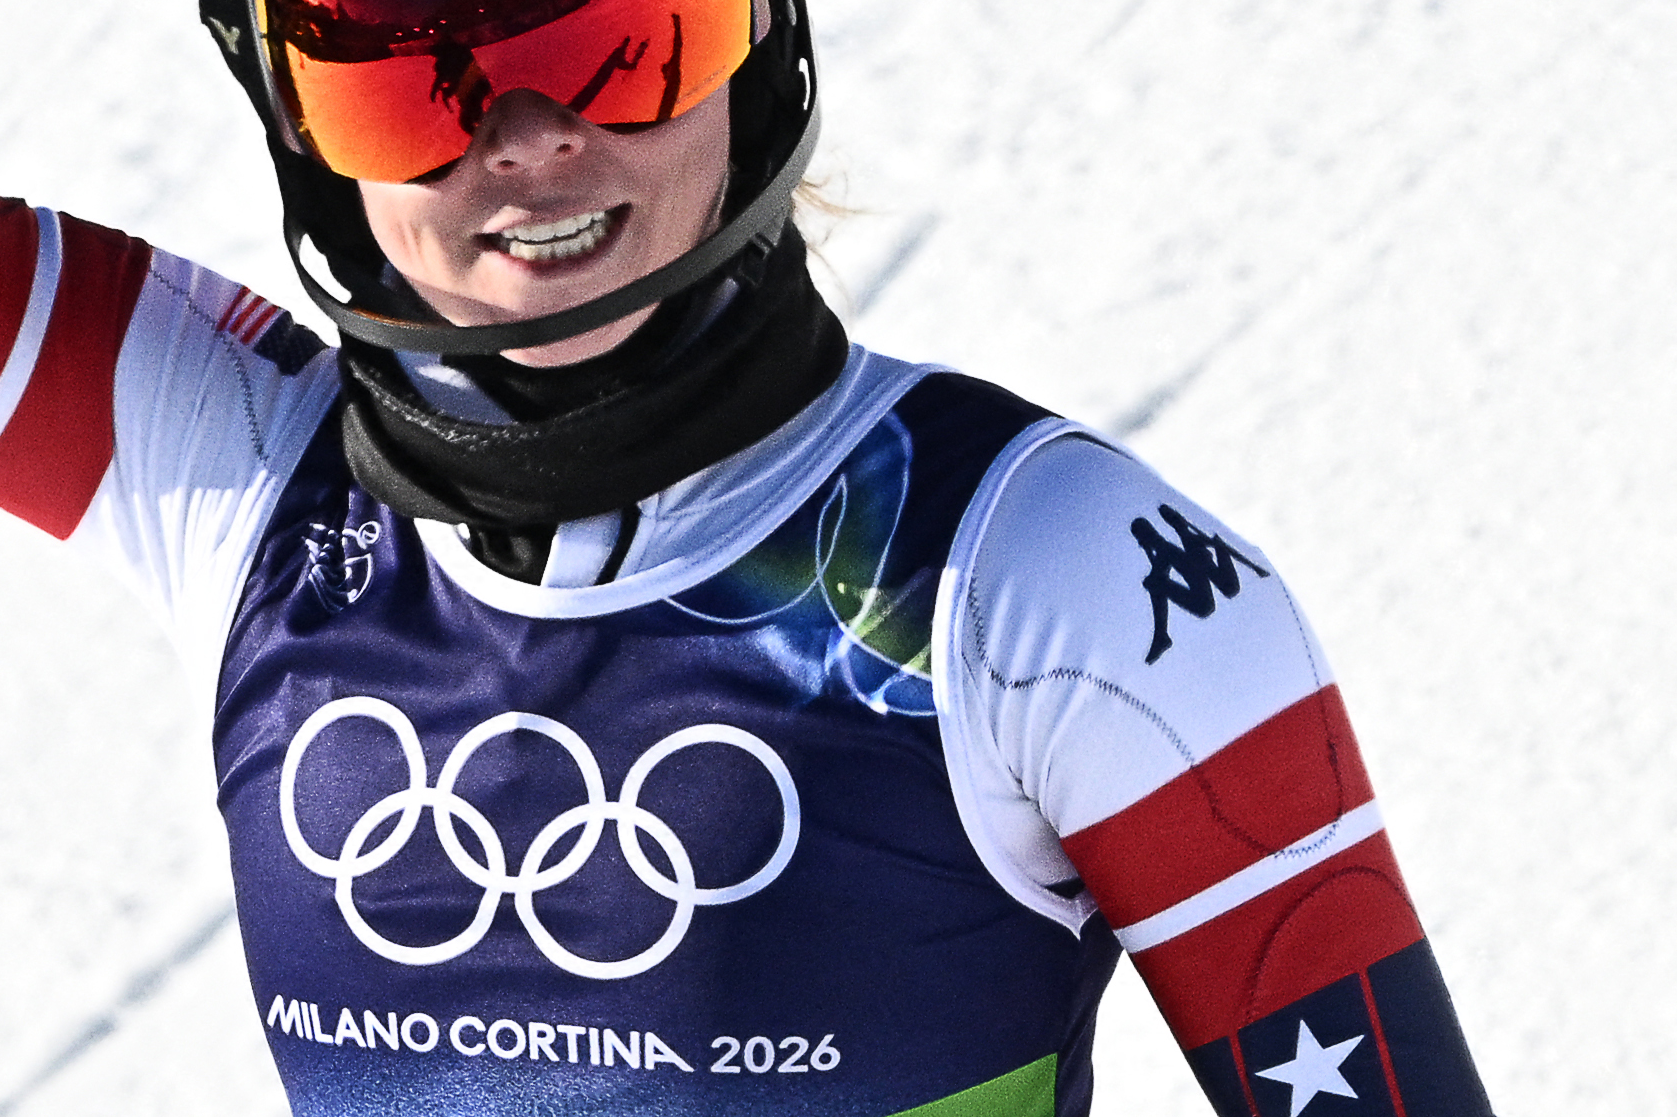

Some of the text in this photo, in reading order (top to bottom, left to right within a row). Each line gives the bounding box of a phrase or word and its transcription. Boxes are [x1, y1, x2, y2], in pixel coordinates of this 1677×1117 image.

[267, 994, 841, 1074] MILANO CORTINA 2026
